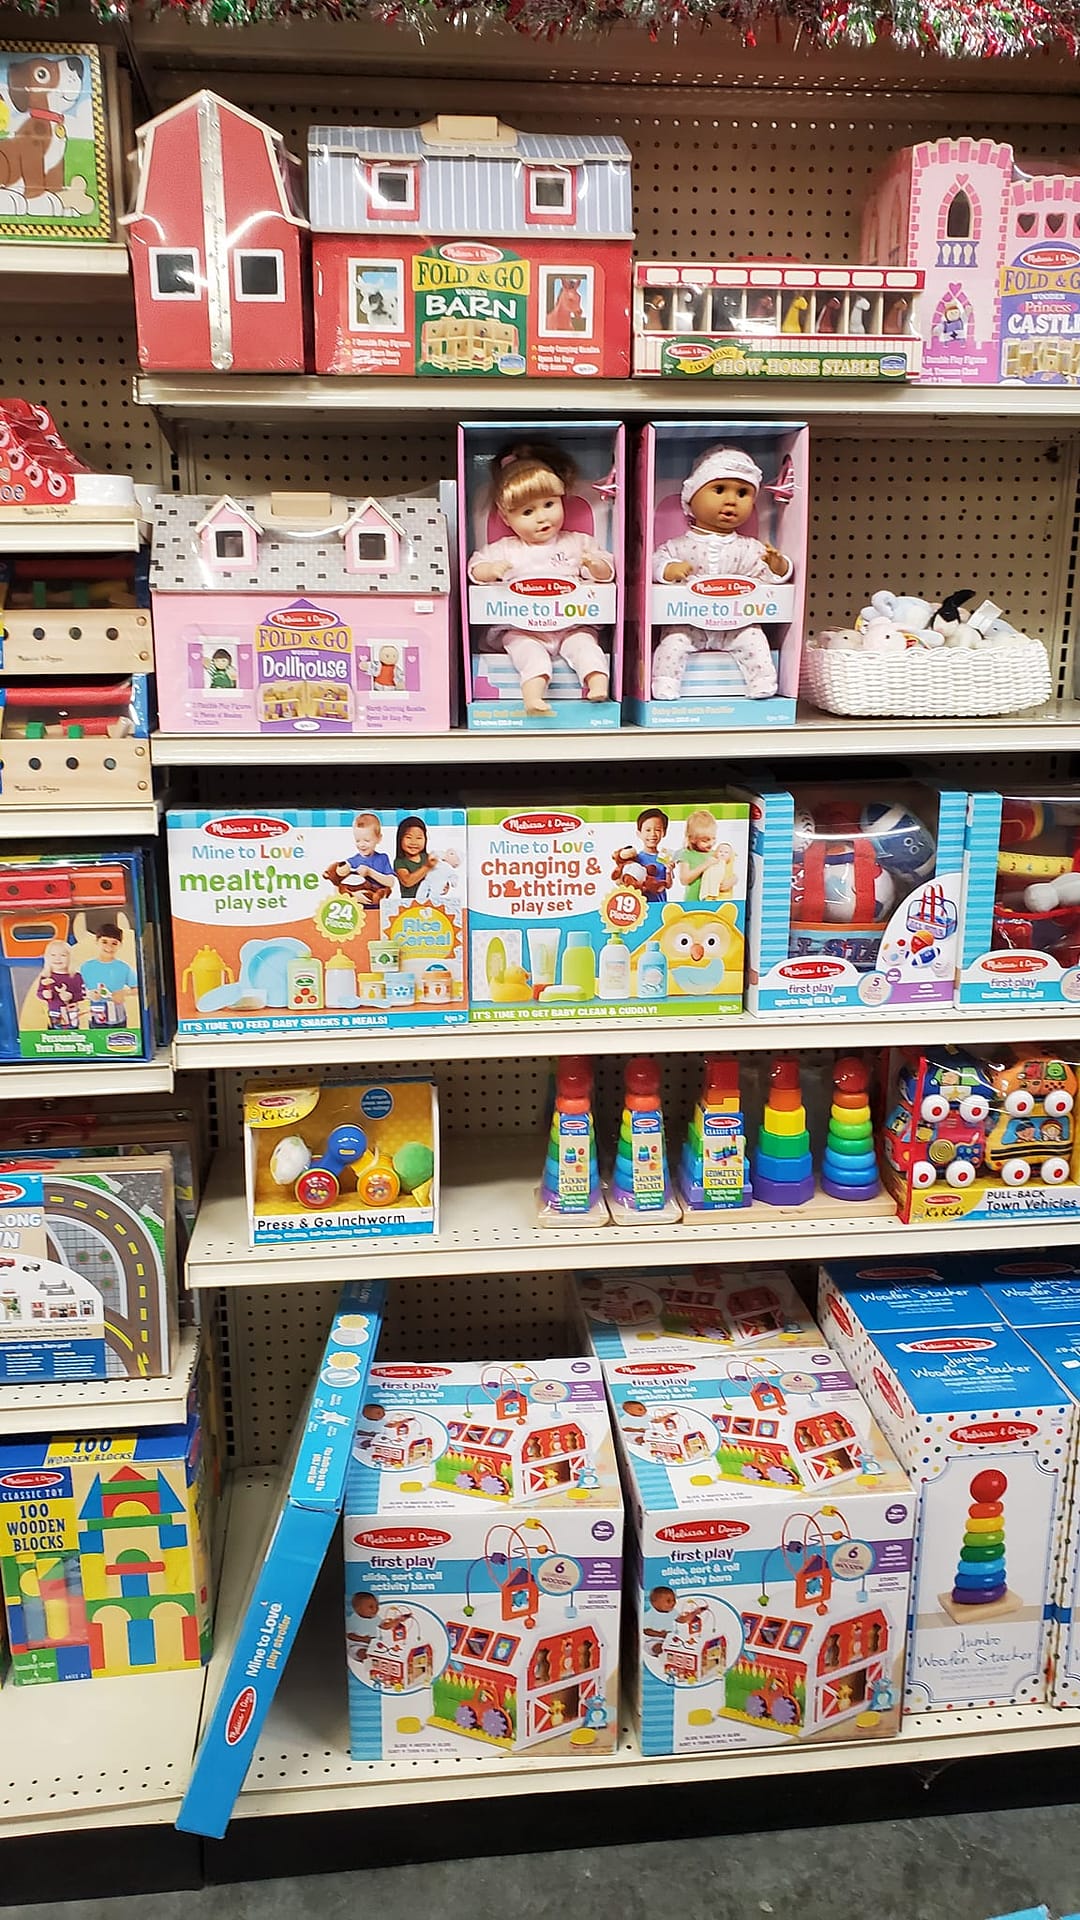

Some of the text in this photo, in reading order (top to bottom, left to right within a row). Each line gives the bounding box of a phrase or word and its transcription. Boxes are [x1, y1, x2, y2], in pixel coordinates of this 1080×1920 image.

[417, 261, 524, 290] FOLD & GO
[1004, 270, 1067, 291] FOLD &
[425, 294, 517, 319] BARN
[1025, 301, 1072, 314] Princess
[821, 357, 880, 377] STABLE
[486, 601, 600, 617] Mine to Love
[667, 600, 777, 617] Mine to Love
[528, 619, 558, 627] Natalie
[259, 629, 348, 649] FOLD & GO
[262, 655, 347, 680] Dollhouse
[211, 821, 251, 836] Melissa
[260, 821, 283, 837] Doug
[510, 819, 546, 831] Melissa
[554, 818, 577, 832] Doug
[192, 844, 305, 859] Mine to Love
[489, 839, 595, 854] Mine to Love
[480, 856, 602, 879] changing &
[215, 895, 288, 913] play set
[328, 902, 353, 920] 24
[511, 899, 573, 915] play set
[615, 895, 636, 913] 19
[402, 918, 442, 933] Rice
[393, 931, 453, 947] Cereal
[789, 983, 834, 995] first play
[872, 977, 881, 987] 5
[991, 977, 1037, 988] first play
[472, 1011, 491, 1020] IT'S
[494, 1010, 515, 1019] TIME
[517, 1010, 530, 1018] TO
[531, 1009, 549, 1018] GET
[551, 1008, 578, 1018] BABY
[579, 1007, 608, 1017] CLEAN
[618, 1005, 658, 1015] CUDDLY!
[182, 1015, 388, 1031] IT'S TIME TO FEED BABY SNACKS & MEALS!
[987, 1190, 1046, 1200] PULL-BACK
[987, 1198, 1077, 1211] Town Vehicles
[257, 1214, 406, 1231] Press & Go Inchworm
[860, 1287, 970, 1303] Wooden Stacker
[1000, 1285, 1053, 1298] Wooden
[944, 1352, 990, 1368] Jumbo
[911, 1361, 1032, 1379] Wooden Stacker
[381, 1381, 439, 1390] first play
[545, 1383, 554, 1391] 6
[632, 1378, 688, 1387] first play
[957, 1429, 998, 1441] Melissa
[1007, 1425, 1032, 1439] Doug
[73, 1437, 112, 1454] 100
[47, 1452, 133, 1465] WOODEN BLOCKS
[2, 1488, 63, 1501] CLASSIC TOY
[19, 1503, 49, 1519] 100
[6, 1518, 66, 1536] WOODEN
[663, 1524, 743, 1541] Melissa & Doug
[12, 1535, 64, 1552] BLOCKS
[362, 1532, 443, 1546] Melissa & Doug
[671, 1547, 734, 1562] first play
[848, 1546, 858, 1559] 6
[370, 1556, 436, 1569] first play
[555, 1561, 565, 1573] 6
[690, 1565, 712, 1575] sort
[713, 1563, 721, 1573] &
[723, 1562, 741, 1572] roll
[362, 1571, 443, 1582] slide, sort & roll
[669, 1574, 733, 1586] activity barn
[370, 1582, 435, 1592] activity barn
[246, 1603, 283, 1677] Mine to Love
[266, 1615, 292, 1670] play stroller
[950, 1631, 1001, 1653] Jumbo
[918, 1647, 1032, 1668] Wooden Stacker
